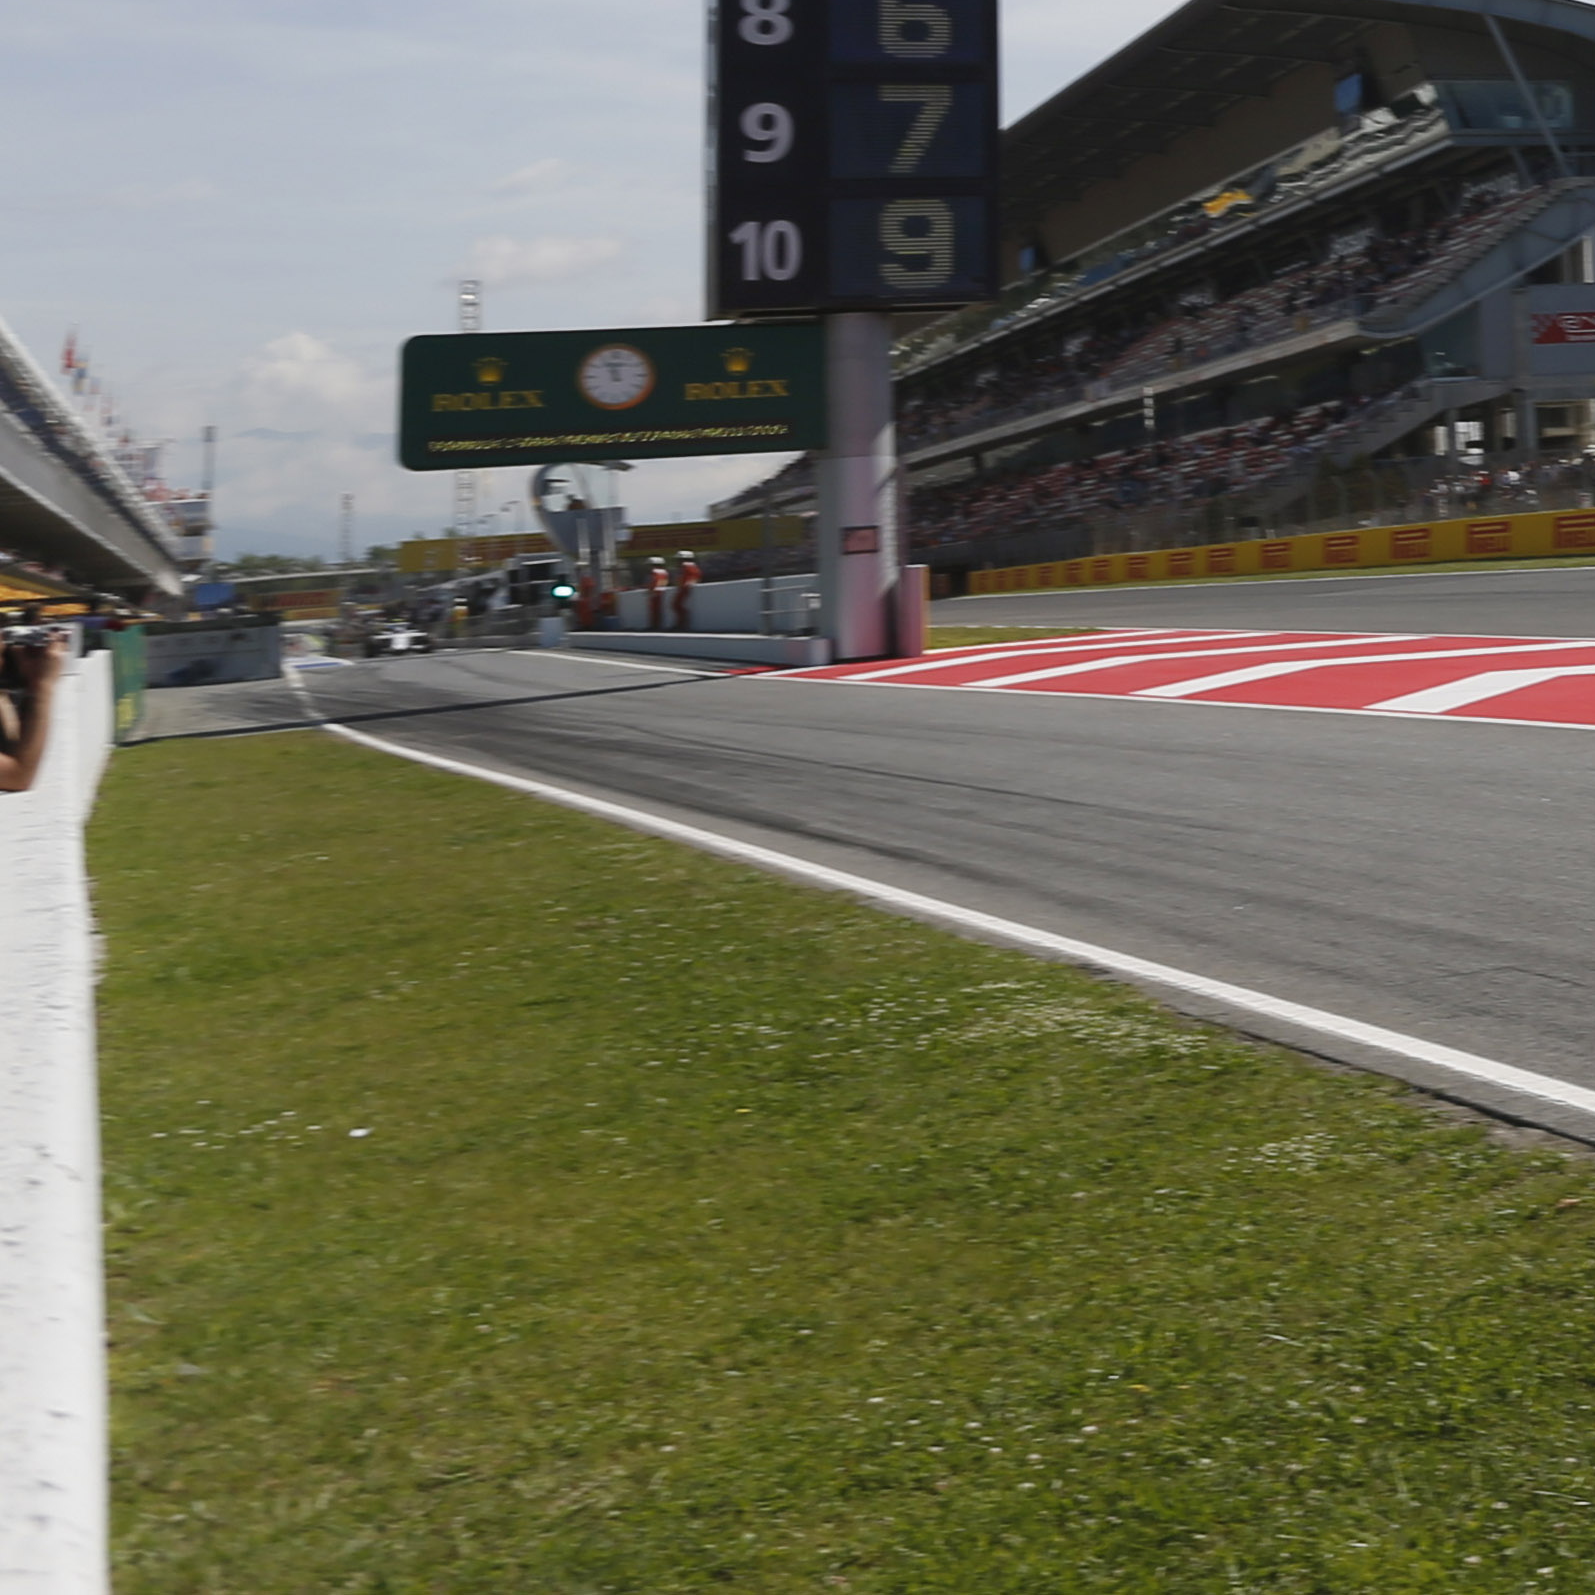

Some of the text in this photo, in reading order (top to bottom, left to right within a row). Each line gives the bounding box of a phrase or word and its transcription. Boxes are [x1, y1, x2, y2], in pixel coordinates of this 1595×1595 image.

[739, 85, 953, 173] 9 7
[729, 199, 954, 289] 10 9
[432, 390, 544, 411] ROLEX
[685, 379, 789, 400] ROLEX
